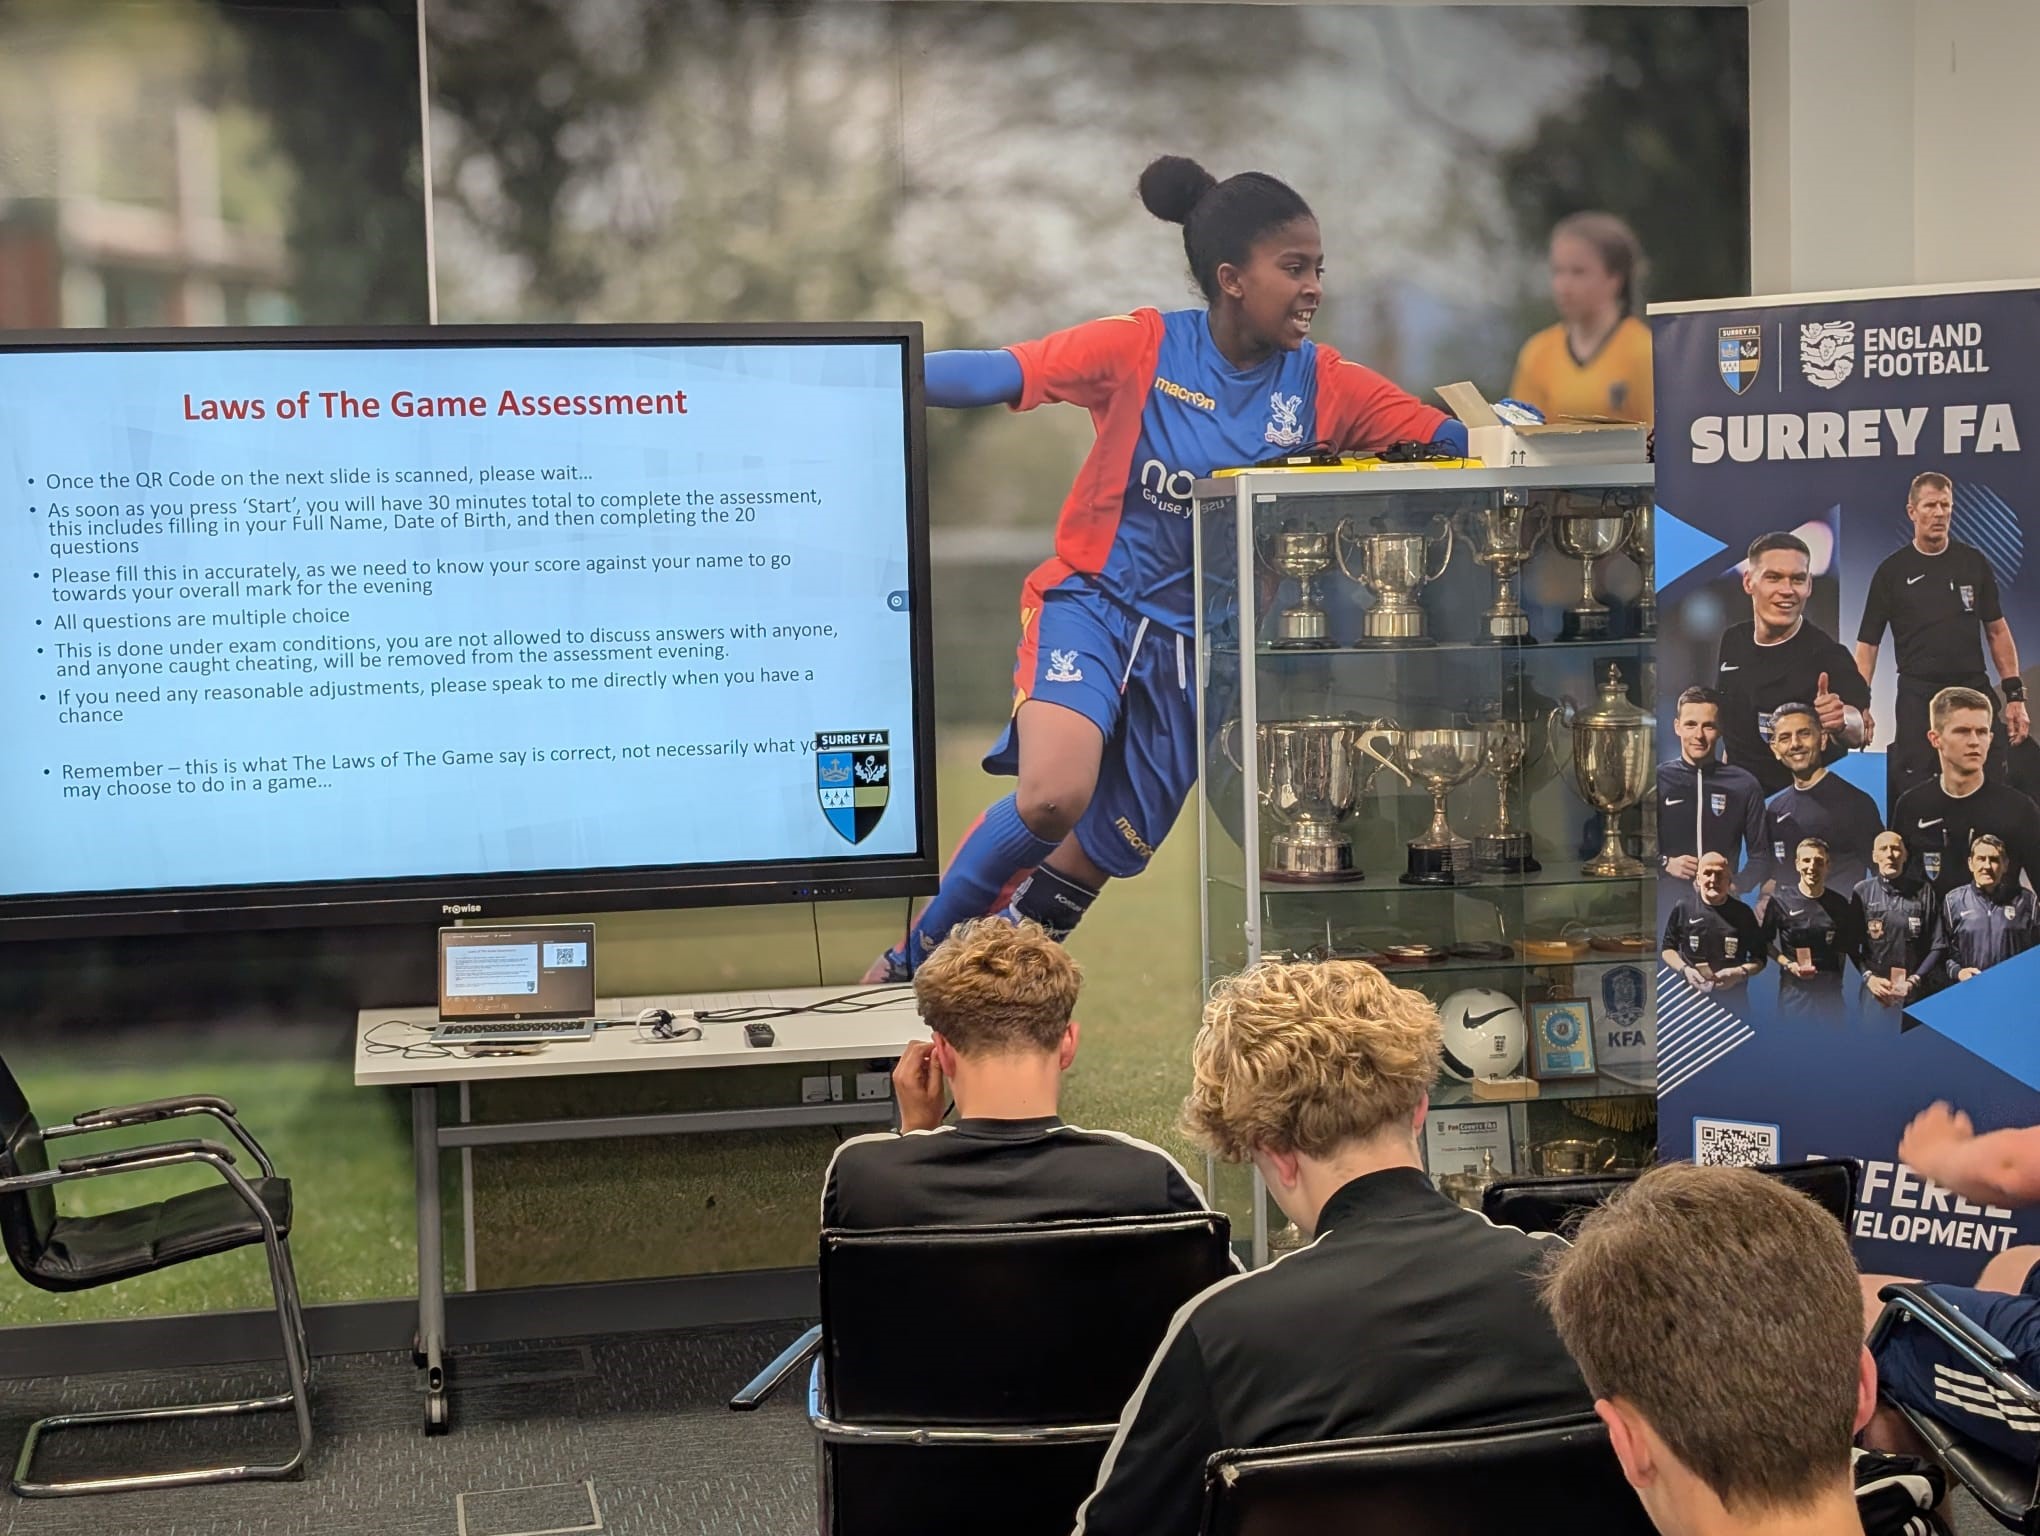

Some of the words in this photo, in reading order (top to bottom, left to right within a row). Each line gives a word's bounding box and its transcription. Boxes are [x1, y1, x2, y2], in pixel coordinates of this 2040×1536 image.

[1864, 322, 1982, 352] ENGLAND
[1864, 349, 1990, 379] FOOTBALL
[184, 393, 265, 420] Laws
[276, 390, 310, 419] of
[318, 389, 379, 418] The
[390, 391, 486, 417] Game
[497, 389, 687, 416] Assessment
[1690, 406, 1929, 464] SURREY
[1943, 403, 2021, 455] FA
[46, 473, 93, 489] Once
[99, 471, 129, 488] the
[135, 471, 162, 490] QR
[168, 470, 214, 486] Code
[220, 473, 243, 485] on
[248, 468, 279, 485] the
[285, 469, 324, 484] next
[329, 467, 370, 484] slide
[376, 468, 389, 483] is
[395, 465, 472, 484] scanned,
[479, 465, 534, 485] please
[47, 502, 69, 517] As
[75, 504, 119, 517] soon
[125, 503, 144, 516] as
[149, 503, 182, 519] you
[189, 501, 236, 519] press
[306, 500, 338, 516] you
[344, 495, 374, 511] will
[381, 495, 422, 511] have
[428, 495, 449, 510] 30
[455, 494, 526, 509] minutes
[531, 491, 571, 508] total
[576, 493, 594, 507] to
[600, 490, 680, 510] complete
[685, 489, 714, 505] the
[719, 489, 821, 505] assessment,
[1142, 488, 1157, 504] Go
[1158, 501, 1182, 514] use
[48, 519, 82, 536] this
[87, 517, 163, 535] includes
[167, 516, 218, 536] filling
[224, 517, 239, 532] in
[245, 519, 286, 536] your
[292, 514, 323, 531] Full
[330, 515, 387, 531] Name,
[394, 514, 434, 528] Date
[440, 511, 458, 528] of
[464, 511, 510, 529] Birth,
[517, 510, 548, 526] and
[554, 509, 594, 525] then
[600, 508, 696, 527] completing
[700, 506, 728, 522] the
[734, 507, 755, 521] 20
[50, 538, 138, 558] questions
[52, 566, 110, 583] Please
[115, 564, 137, 581] fill
[143, 564, 176, 581] this
[182, 564, 198, 580] in
[204, 561, 300, 581] accurately,
[306, 564, 325, 577] as
[330, 564, 356, 576] we
[363, 558, 406, 575] need
[412, 560, 430, 574] to
[436, 557, 484, 573] know
[489, 560, 529, 576] your
[534, 559, 580, 571] score
[586, 555, 647, 574] against
[651, 556, 690, 572] your
[696, 555, 743, 567] name
[747, 552, 765, 566] to
[770, 554, 790, 569] go
[51, 583, 126, 601] towards
[131, 586, 173, 603] your
[179, 580, 239, 598] overall
[246, 579, 291, 596] mark
[296, 579, 322, 595] for
[327, 578, 357, 594] the
[363, 577, 432, 596] evening
[53, 613, 76, 630] All
[82, 612, 171, 633] questions
[177, 614, 205, 626] are
[212, 607, 286, 628] multiple
[292, 607, 349, 623] choice
[54, 641, 92, 658] This
[97, 641, 111, 657] is
[117, 640, 163, 656] done
[169, 638, 223, 655] under
[228, 640, 276, 653] exam
[282, 634, 380, 651] conditions,
[386, 636, 418, 652] you
[424, 635, 452, 647] are
[458, 632, 488, 646] not
[493, 628, 560, 645] allowed
[566, 629, 584, 643] to
[589, 627, 650, 642] discuss
[655, 627, 724, 640] answers
[729, 622, 766, 638] with
[772, 624, 837, 640] anyone,
[56, 659, 90, 676] and
[96, 661, 162, 679] anyone
[168, 655, 230, 676] caught
[235, 654, 317, 673] cheating,
[323, 651, 353, 668] will
[360, 651, 381, 667] be
[387, 648, 465, 666] removed
[471, 648, 512, 664] from
[518, 646, 547, 662] the
[553, 645, 652, 661] assessment
[658, 642, 728, 660] evening.
[58, 688, 70, 705] If
[75, 691, 108, 708] you
[115, 685, 160, 703] need
[166, 688, 198, 704] any
[204, 681, 303, 700] reasonable
[309, 679, 424, 700] adjustments,
[430, 676, 486, 696] please
[492, 673, 542, 694] speak
[547, 675, 565, 689] to
[571, 676, 598, 688] me
[603, 670, 666, 689] directly
[672, 669, 718, 685] when
[723, 671, 754, 687] you
[760, 666, 799, 682] have
[804, 669, 813, 680] a
[58, 706, 123, 723] chance
[821, 733, 866, 745] SURREY
[868, 733, 884, 744] FA
[62, 760, 163, 779] Remember
[184, 758, 218, 774] this
[223, 758, 236, 773] is
[242, 755, 288, 772] what
[292, 754, 325, 770] The
[332, 754, 375, 769] Laws
[380, 751, 398, 767] of
[403, 750, 436, 766] The
[442, 750, 493, 765] Game
[499, 750, 526, 766] say
[532, 746, 544, 761] is
[550, 745, 616, 761] correct,
[622, 743, 650, 758] not
[656, 738, 748, 757] necessarily
[753, 737, 795, 753] what
[63, 784, 101, 800] may
[106, 778, 171, 795] choose
[176, 778, 195, 793] to
[201, 775, 224, 792] do
[230, 775, 246, 791] in
[252, 778, 261, 790] a
[1607, 1030, 1647, 1048] KFA
[1853, 1209, 2018, 1253] ELOPMENT
